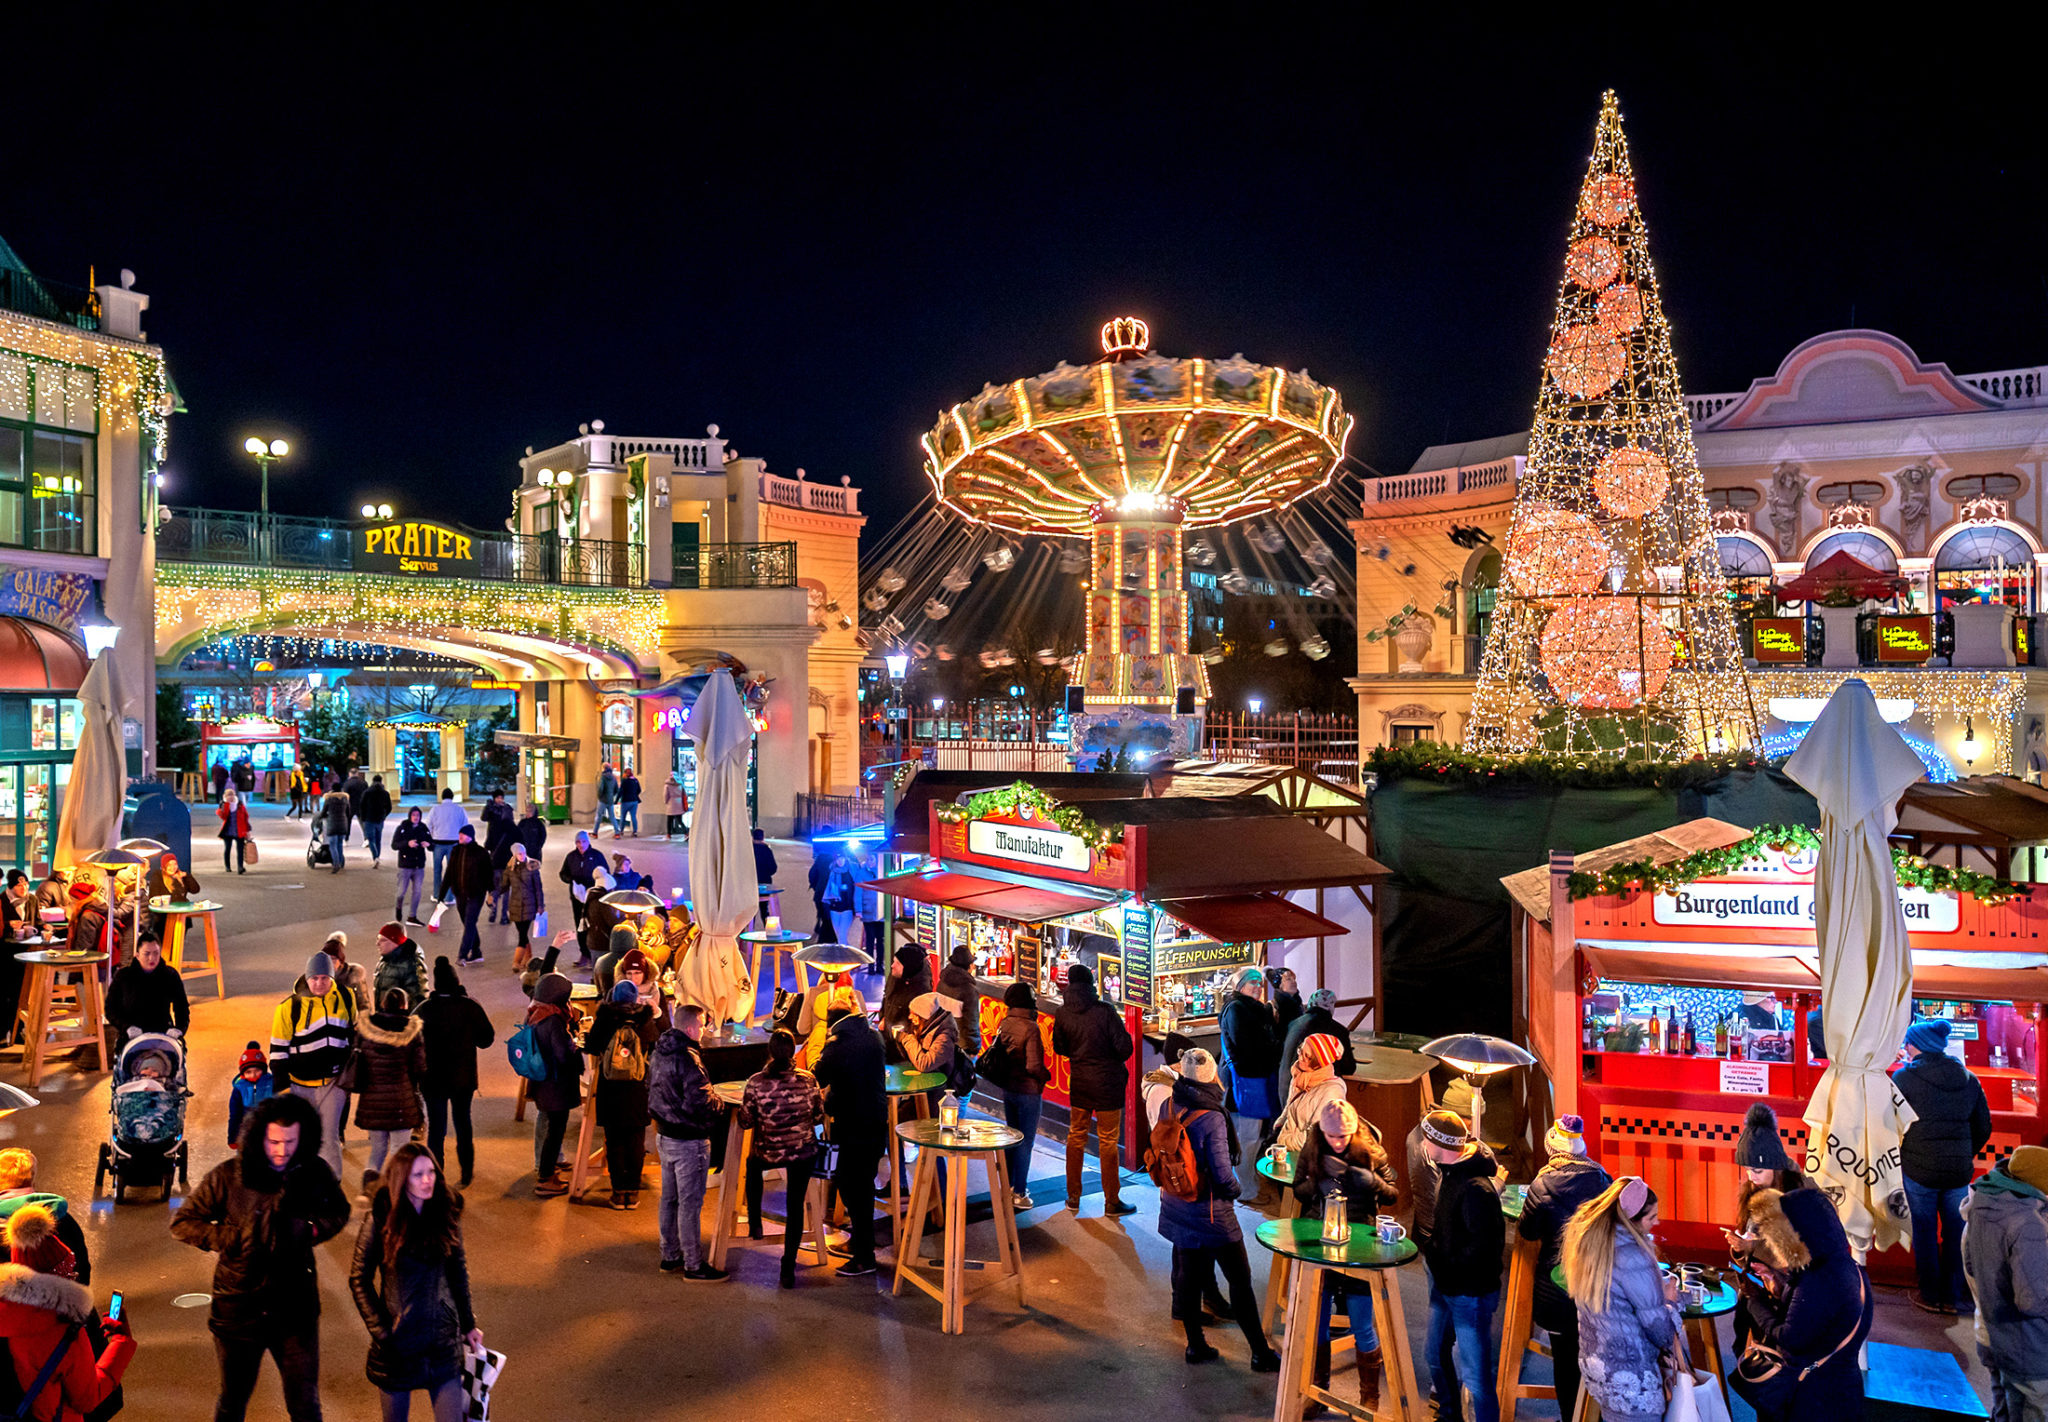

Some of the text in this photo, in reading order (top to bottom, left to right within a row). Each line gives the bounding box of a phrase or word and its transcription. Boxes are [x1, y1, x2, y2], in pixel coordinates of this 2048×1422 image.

[365, 522, 473, 560] PRATER
[399, 557, 439, 572] Servus
[14, 571, 90, 612] CALAFATI
[1674, 891, 1800, 918] Burgenland
[1154, 946, 1241, 966] ELFENPUNSCH
